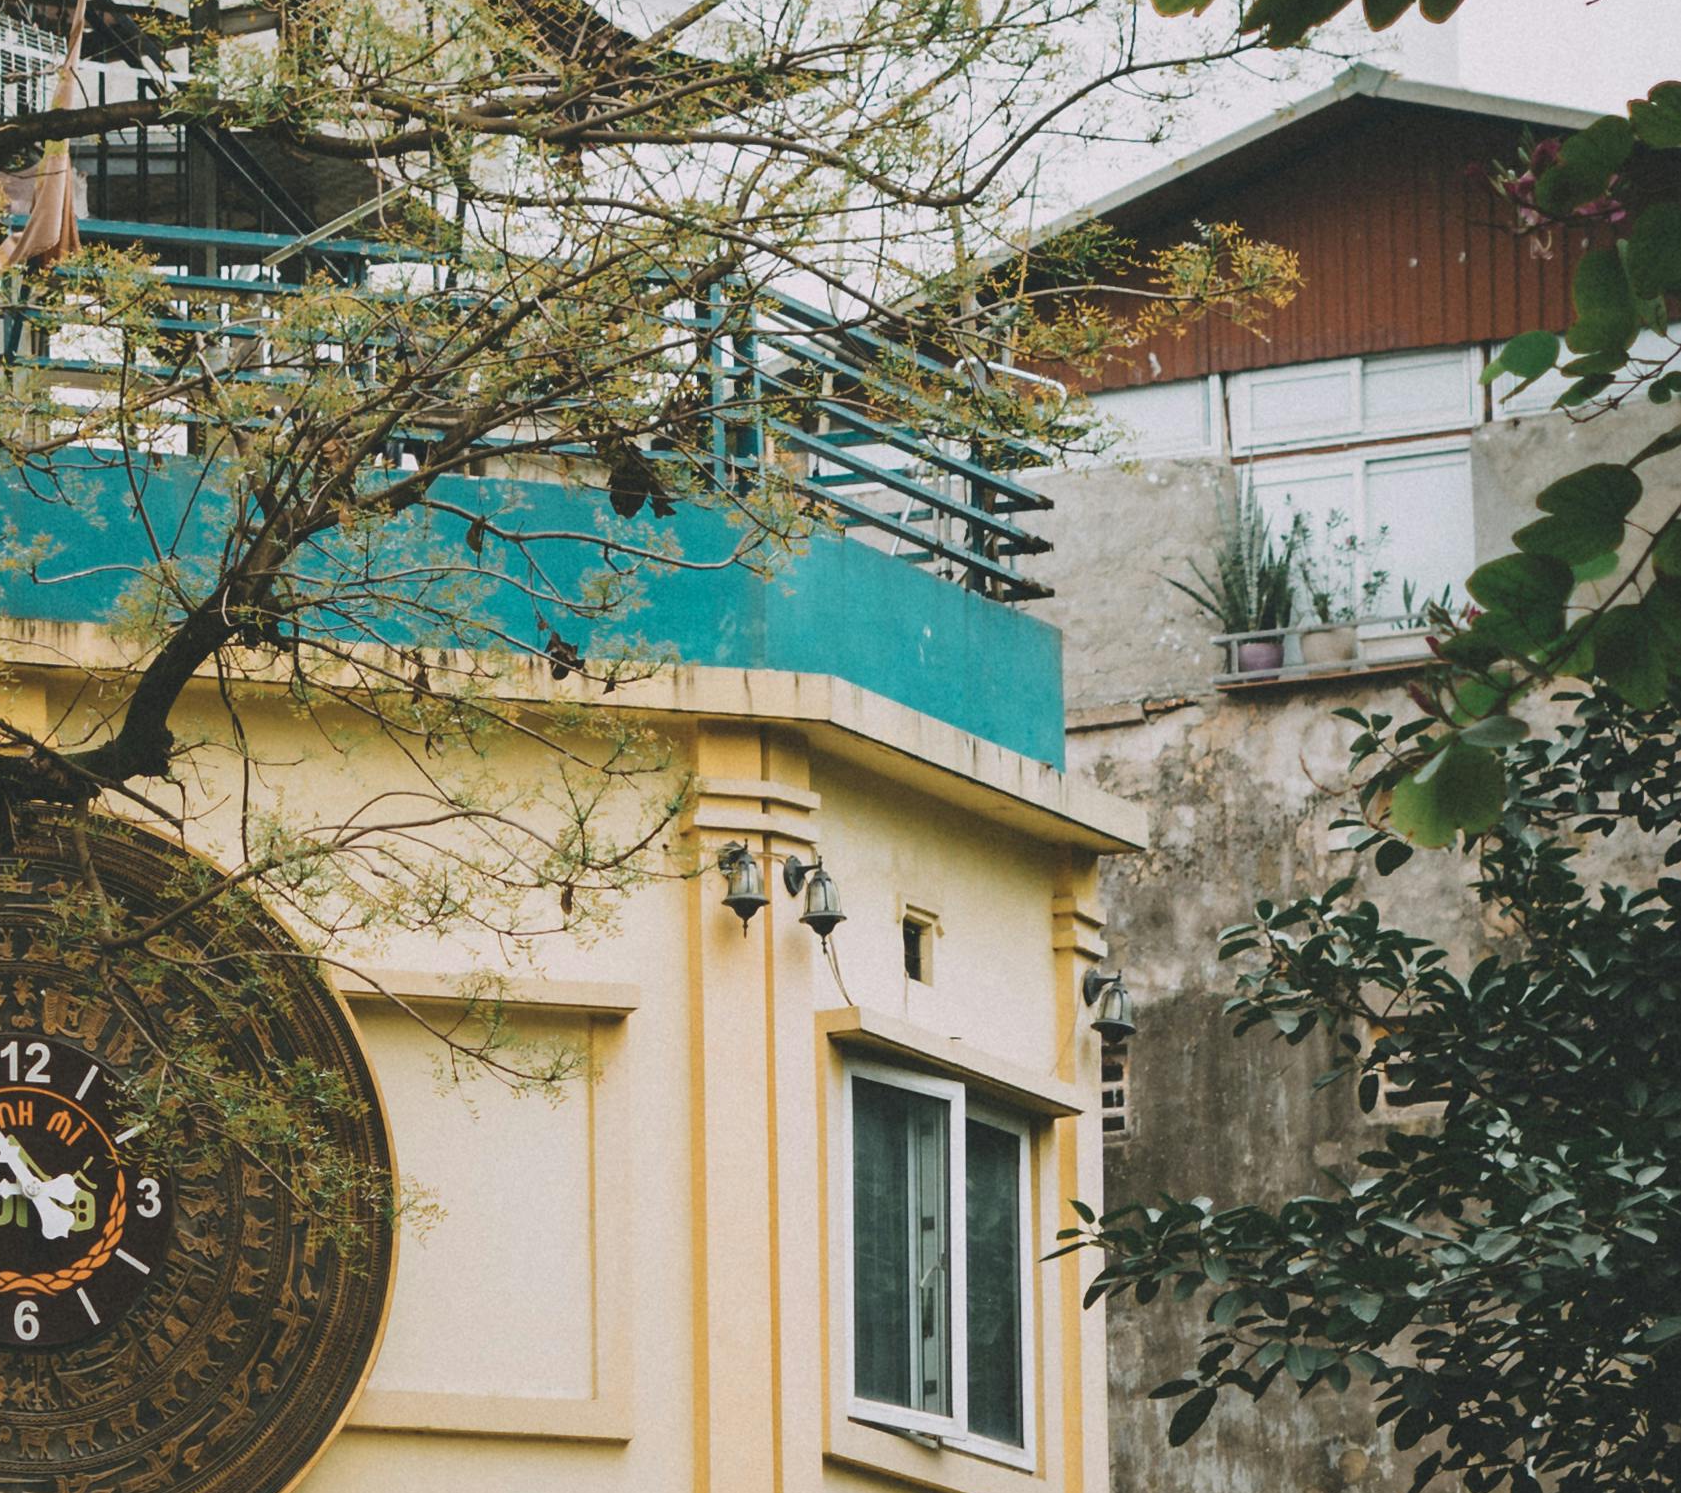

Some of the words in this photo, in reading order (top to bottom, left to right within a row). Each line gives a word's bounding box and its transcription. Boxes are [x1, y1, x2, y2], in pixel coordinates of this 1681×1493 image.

[0, 1041, 51, 1083] 12
[135, 1177, 162, 1218] 3
[13, 1299, 40, 1341] 6
